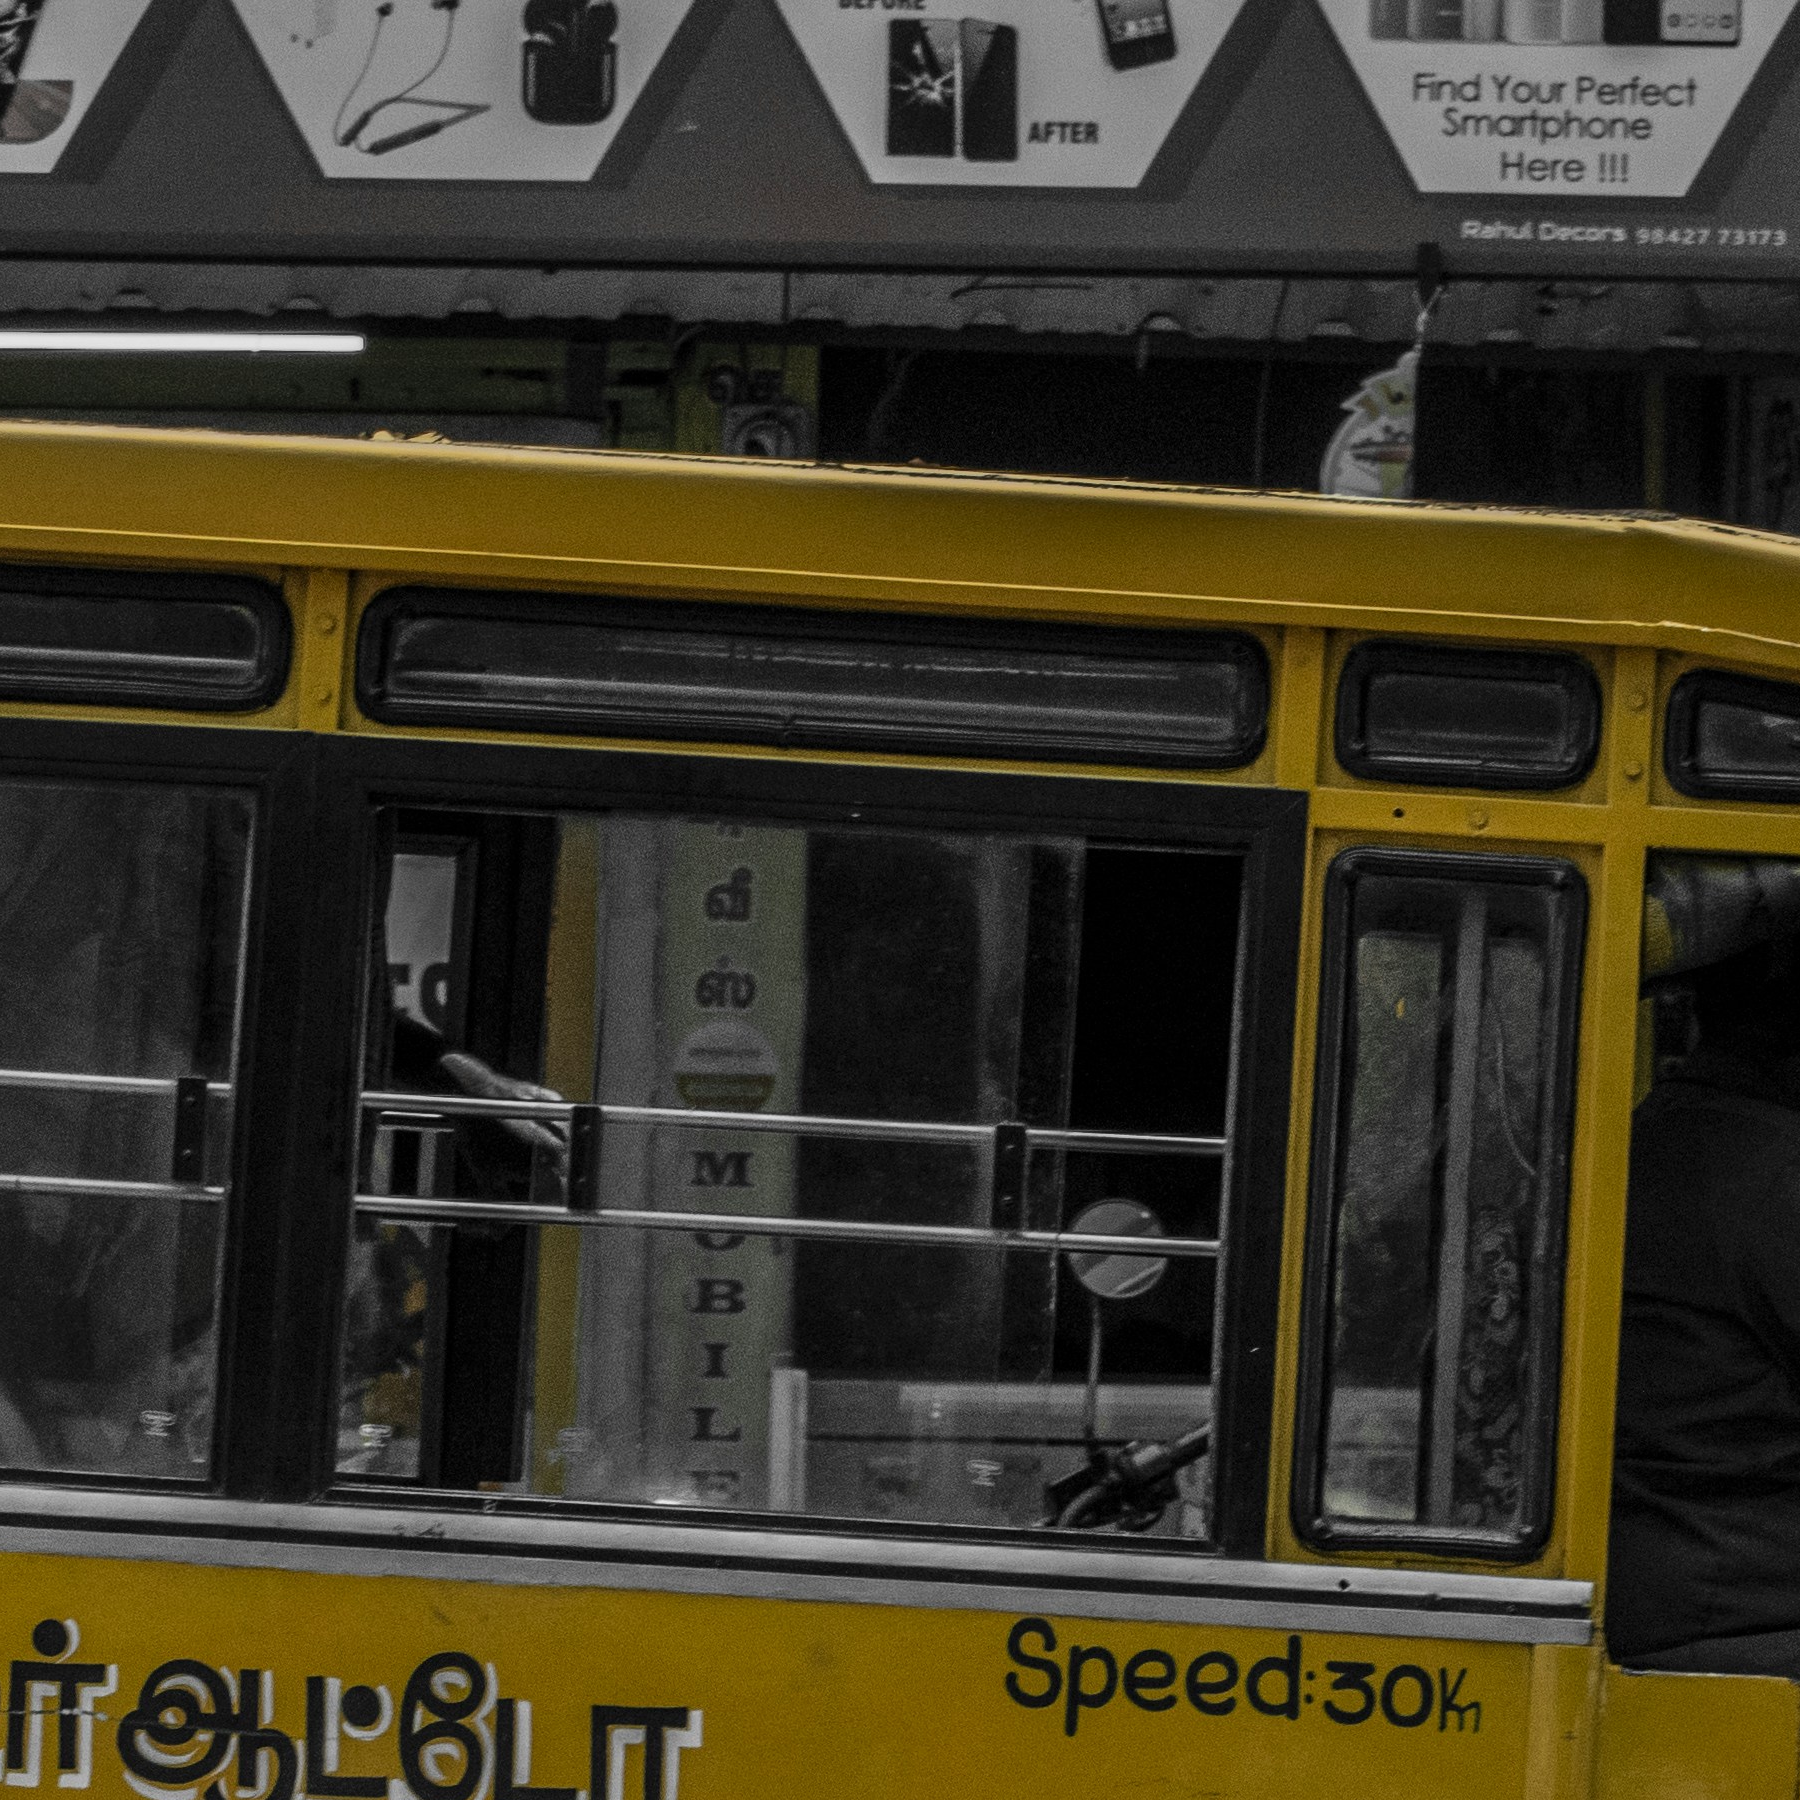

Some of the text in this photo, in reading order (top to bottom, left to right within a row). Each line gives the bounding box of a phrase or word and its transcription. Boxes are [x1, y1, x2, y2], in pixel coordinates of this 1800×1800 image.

[1412, 72, 1696, 106] Find Your Perfect
[1027, 122, 1099, 145] AFTER
[1443, 108, 1652, 144] Smartphone
[1500, 152, 1585, 182] Here
[1460, 220, 1533, 240] Rahul
[1538, 221, 1627, 242] Decors
[1635, 228, 1711, 245] 98427
